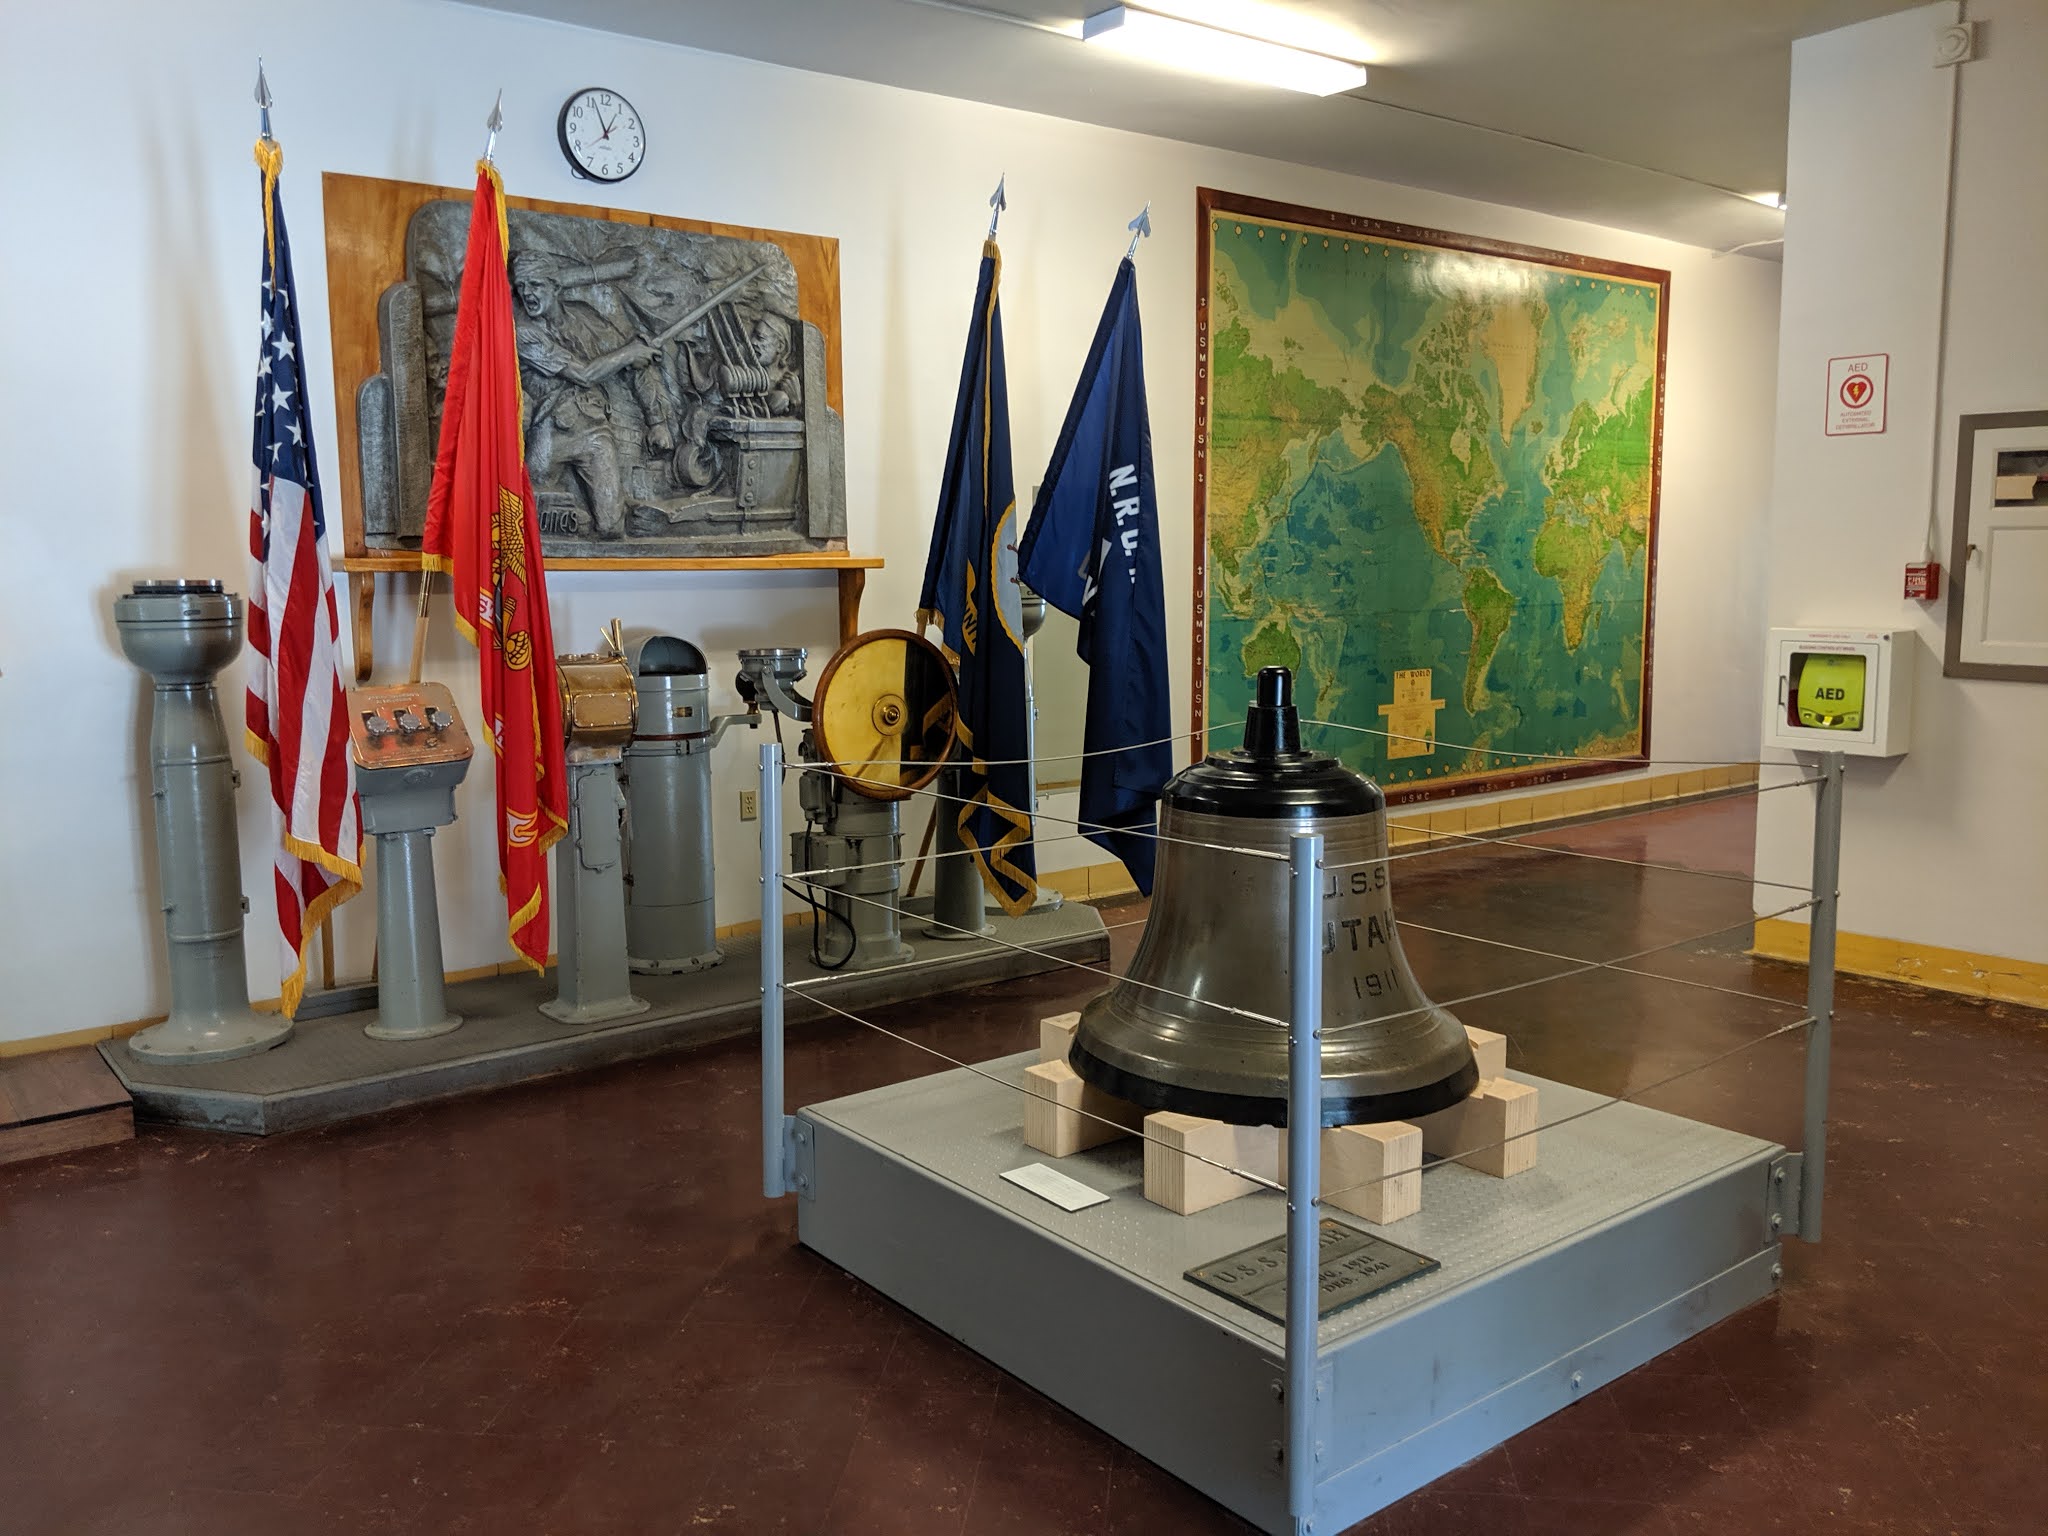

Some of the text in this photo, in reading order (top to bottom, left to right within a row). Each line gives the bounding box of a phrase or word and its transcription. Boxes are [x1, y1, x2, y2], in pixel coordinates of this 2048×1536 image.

[586, 96, 595, 108] 11
[600, 94, 611, 106] 12
[572, 106, 583, 118] 10
[618, 104, 622, 115] 1
[569, 122, 576, 134] 9
[628, 118, 635, 130] 2
[574, 139, 582, 152] 8
[633, 136, 640, 148] 3
[587, 156, 594, 167] 7
[628, 152, 635, 163] 4
[602, 164, 608, 175] 6
[616, 163, 623, 174] 5
[1350, 218, 1380, 229] USN
[1848, 362, 1868, 373] AED
[1198, 417, 1206, 458] USN
[1196, 590, 1204, 643] USMC
[1396, 669, 1431, 679] THE WORLD
[1815, 688, 1845, 700] AED
[1401, 792, 1430, 804] USMC
[1353, 968, 1399, 999] 1911
[1342, 1255, 1375, 1270] 1911
[1322, 1261, 1391, 1293] DEC. 1941
